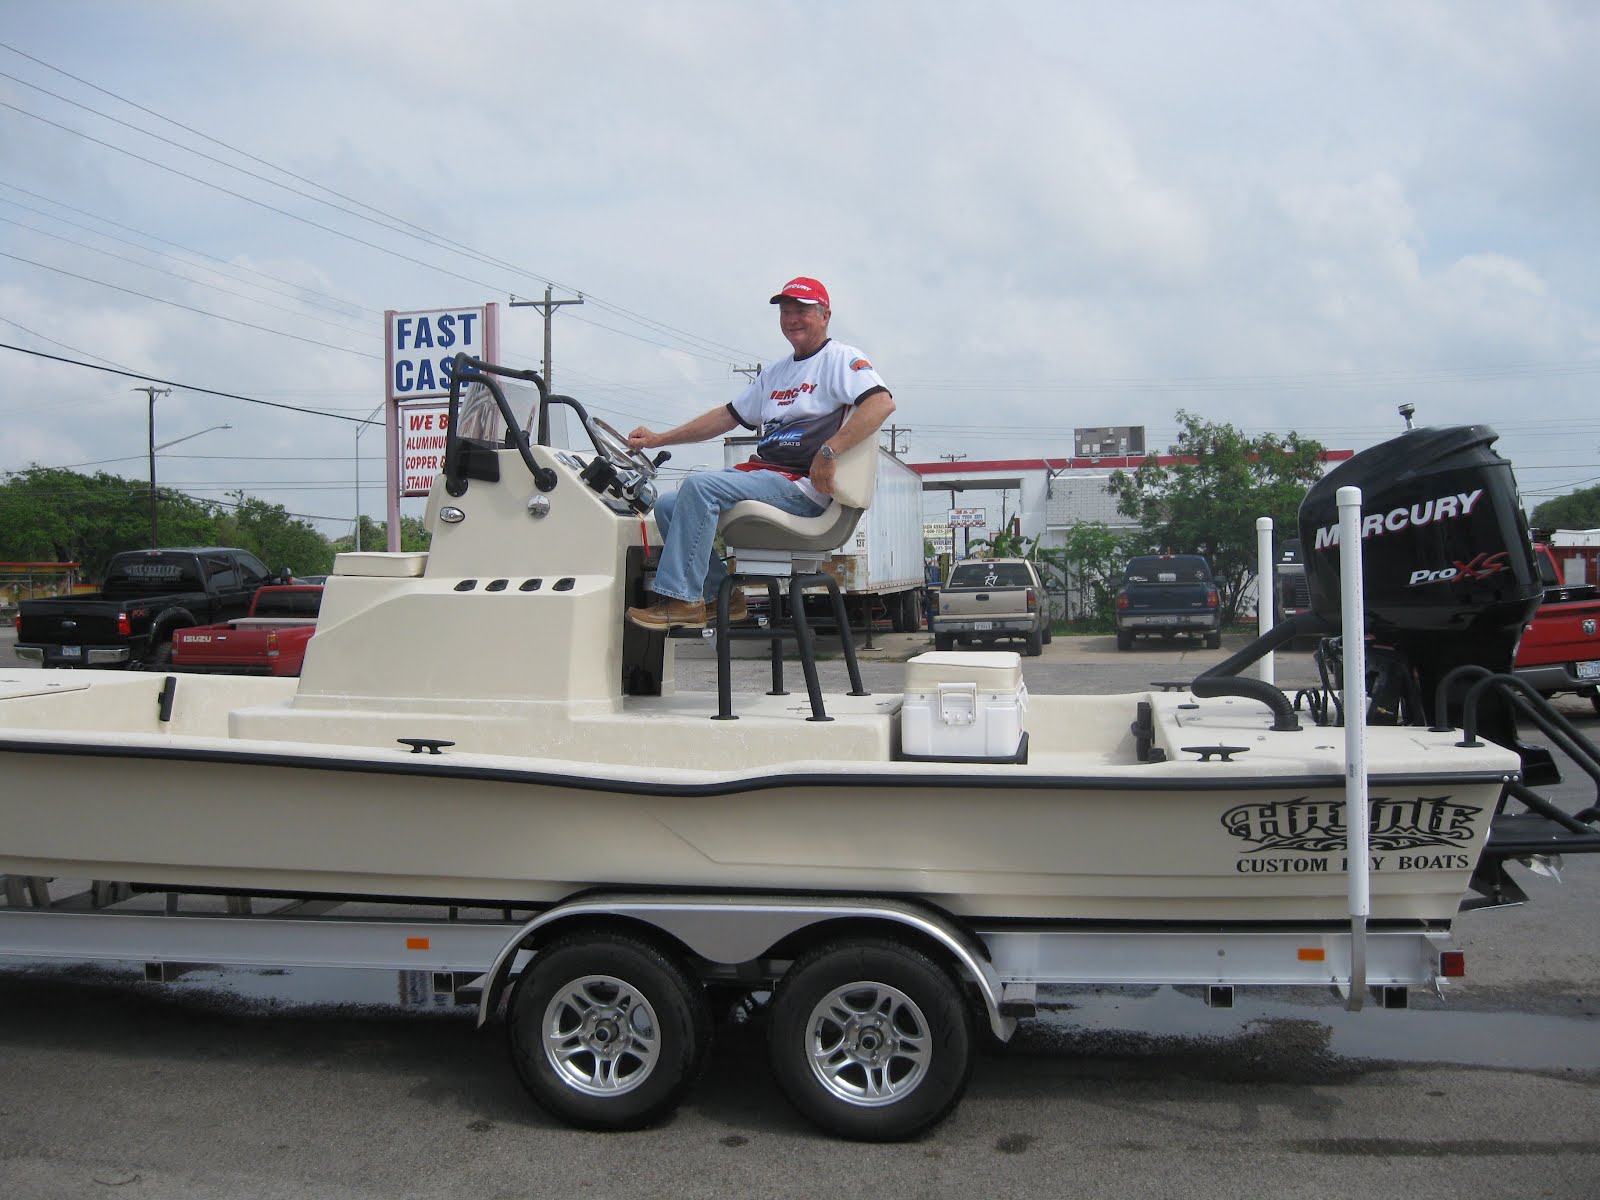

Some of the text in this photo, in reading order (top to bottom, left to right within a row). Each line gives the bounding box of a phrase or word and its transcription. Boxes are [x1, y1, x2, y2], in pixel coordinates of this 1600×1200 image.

[769, 382, 818, 400] ERCRY
[410, 414, 434, 431] WE
[405, 456, 438, 470] COPPER
[406, 475, 433, 490] STAIN
[1314, 488, 1484, 550] MRCURY
[183, 635, 212, 643] ISUZU
[1221, 796, 1483, 843] HANIE
[1236, 858, 1328, 873] CUSTOM
[1399, 854, 1469, 870] BOATS
